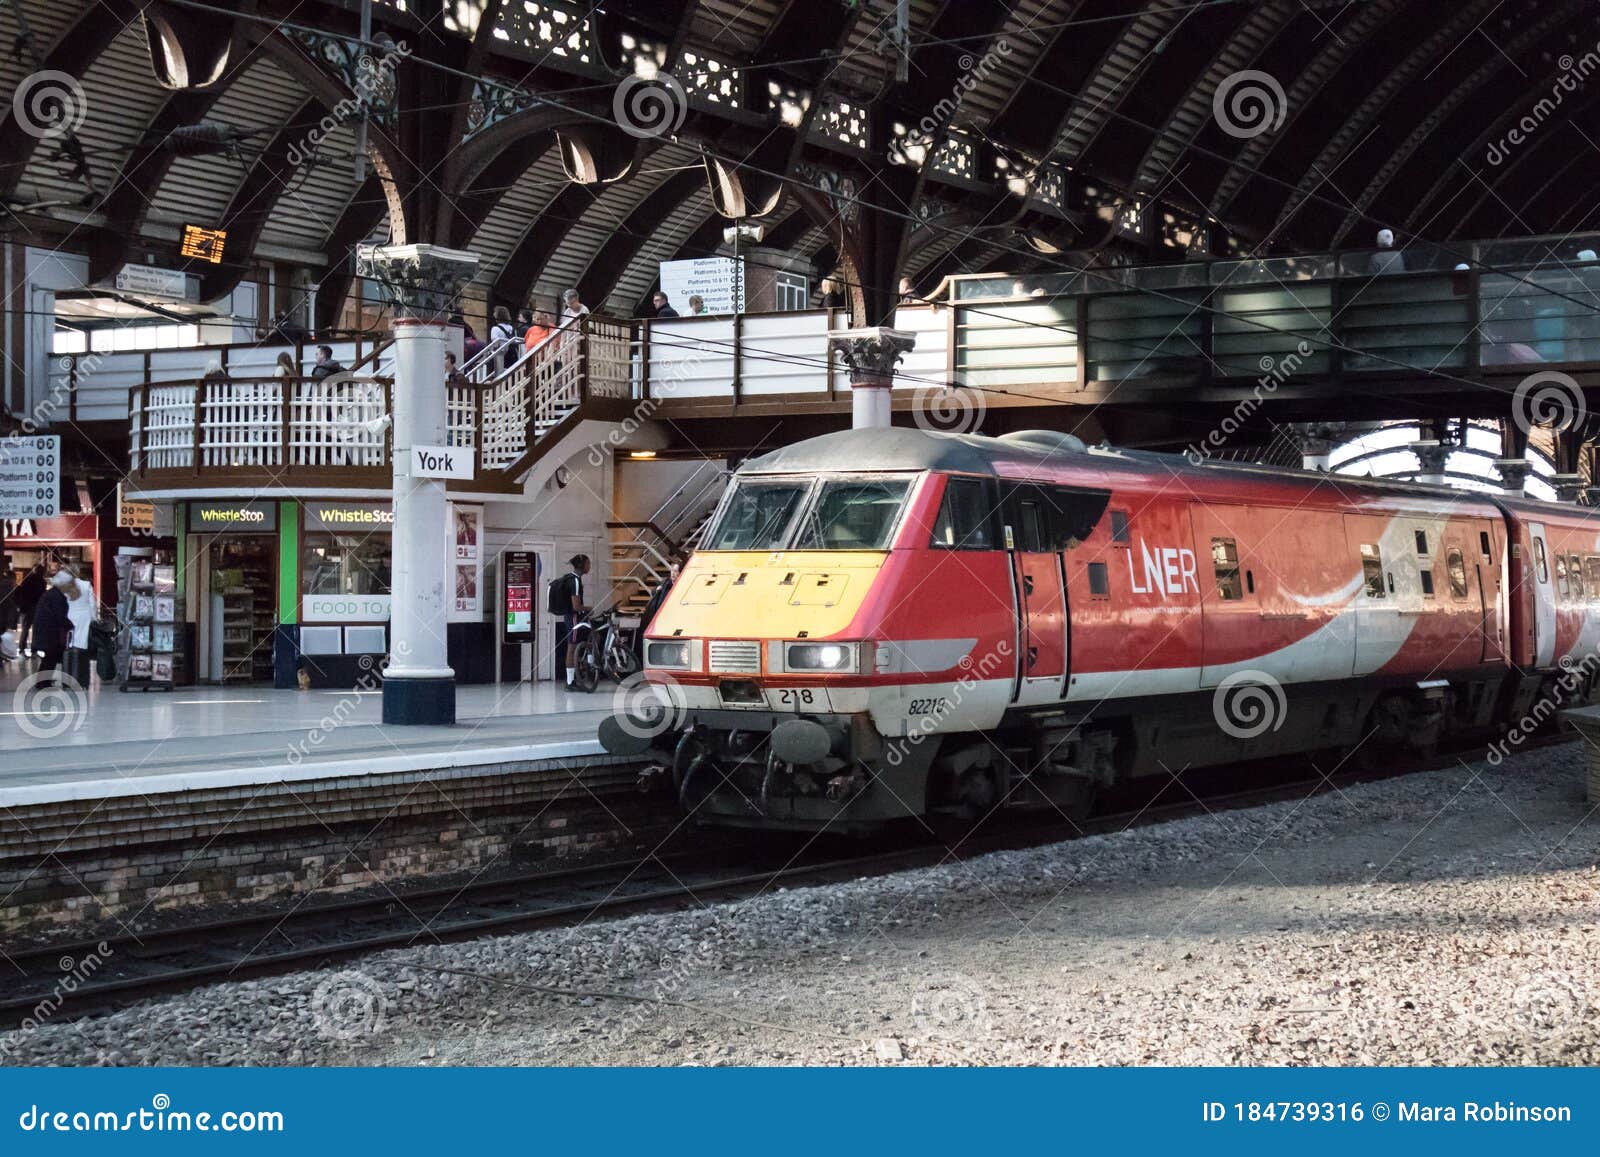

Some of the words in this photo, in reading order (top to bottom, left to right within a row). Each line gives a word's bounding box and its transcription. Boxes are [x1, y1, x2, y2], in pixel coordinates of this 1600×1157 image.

[418, 451, 454, 472] York
[201, 509, 264, 524] WhistleStop
[320, 509, 394, 523] WhistleSto
[1126, 535, 1200, 602] LNER
[312, 602, 358, 614] FOOD
[363, 602, 383, 614] TO
[779, 689, 813, 704] 218
